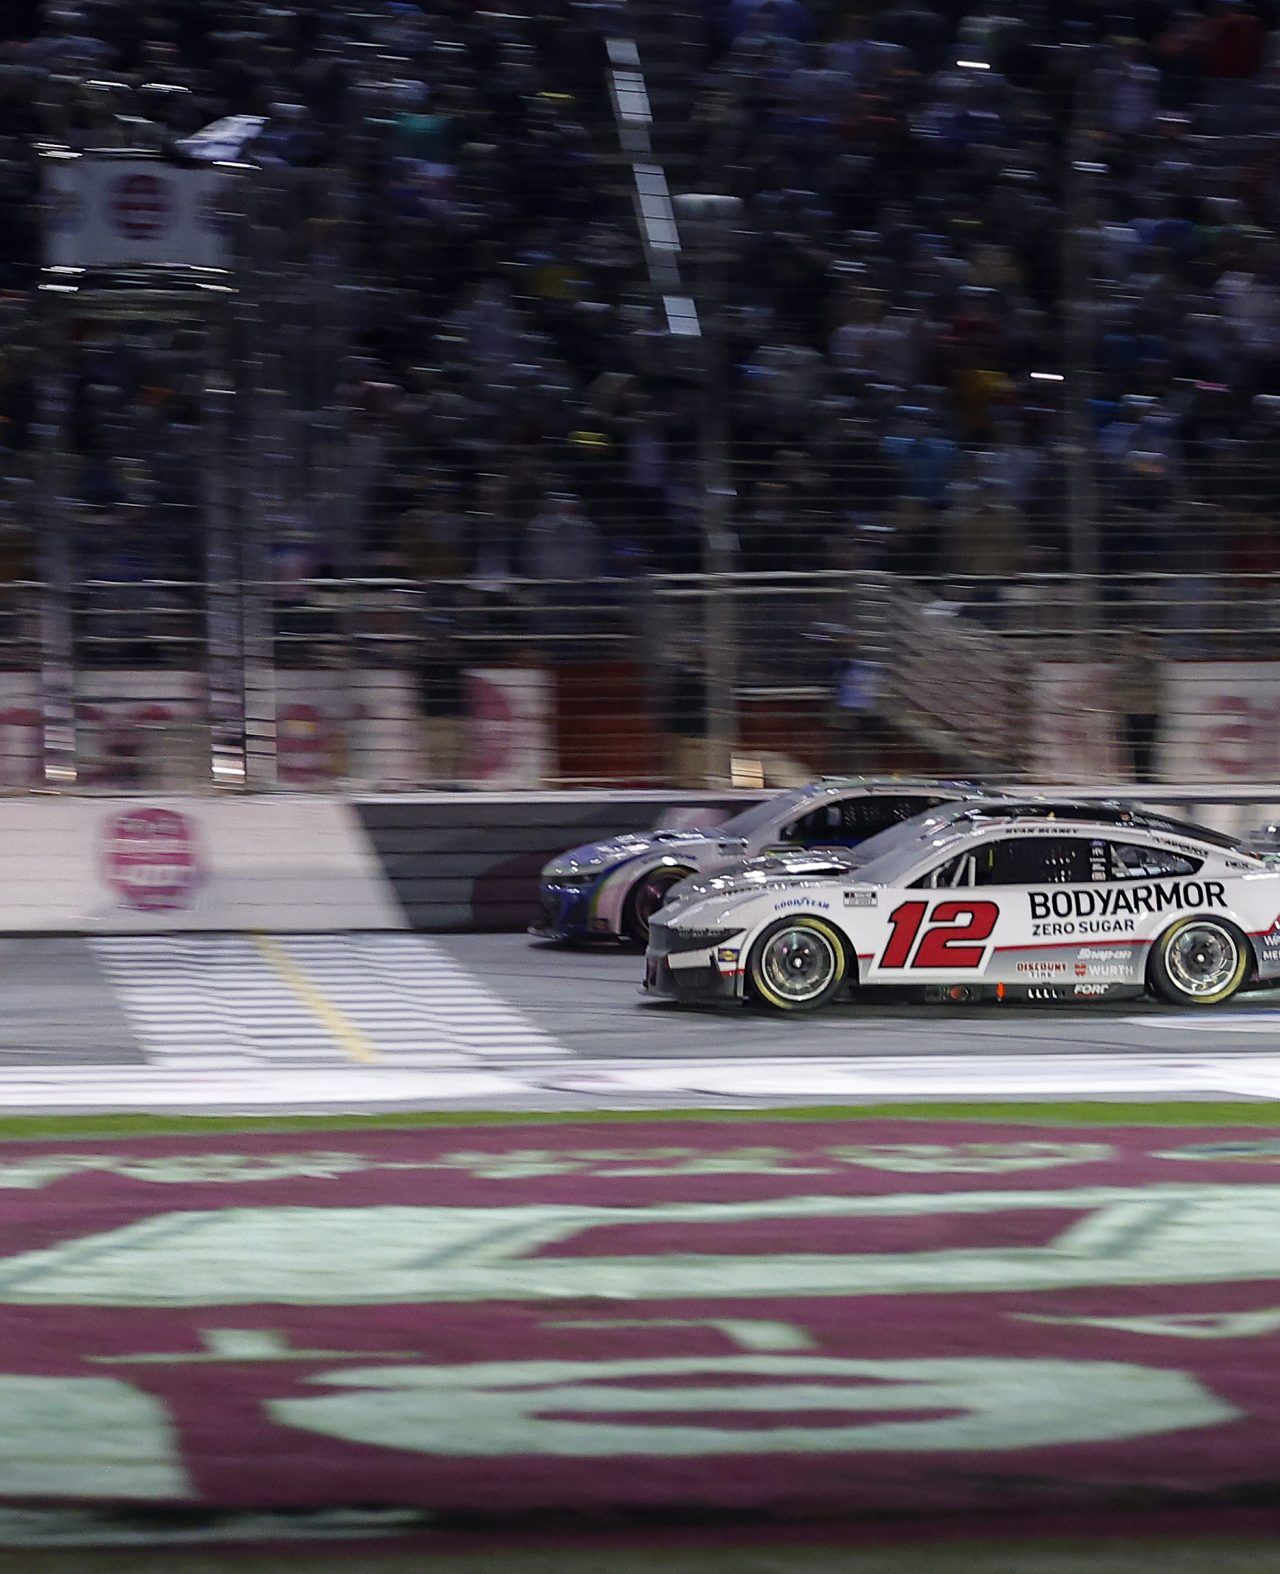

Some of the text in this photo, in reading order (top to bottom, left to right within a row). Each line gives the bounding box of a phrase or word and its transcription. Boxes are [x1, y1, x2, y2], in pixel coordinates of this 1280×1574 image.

[1028, 881, 1228, 920] BODYARMOR
[877, 900, 1001, 969] 12
[1032, 919, 1135, 936] ZERO SUGAR
